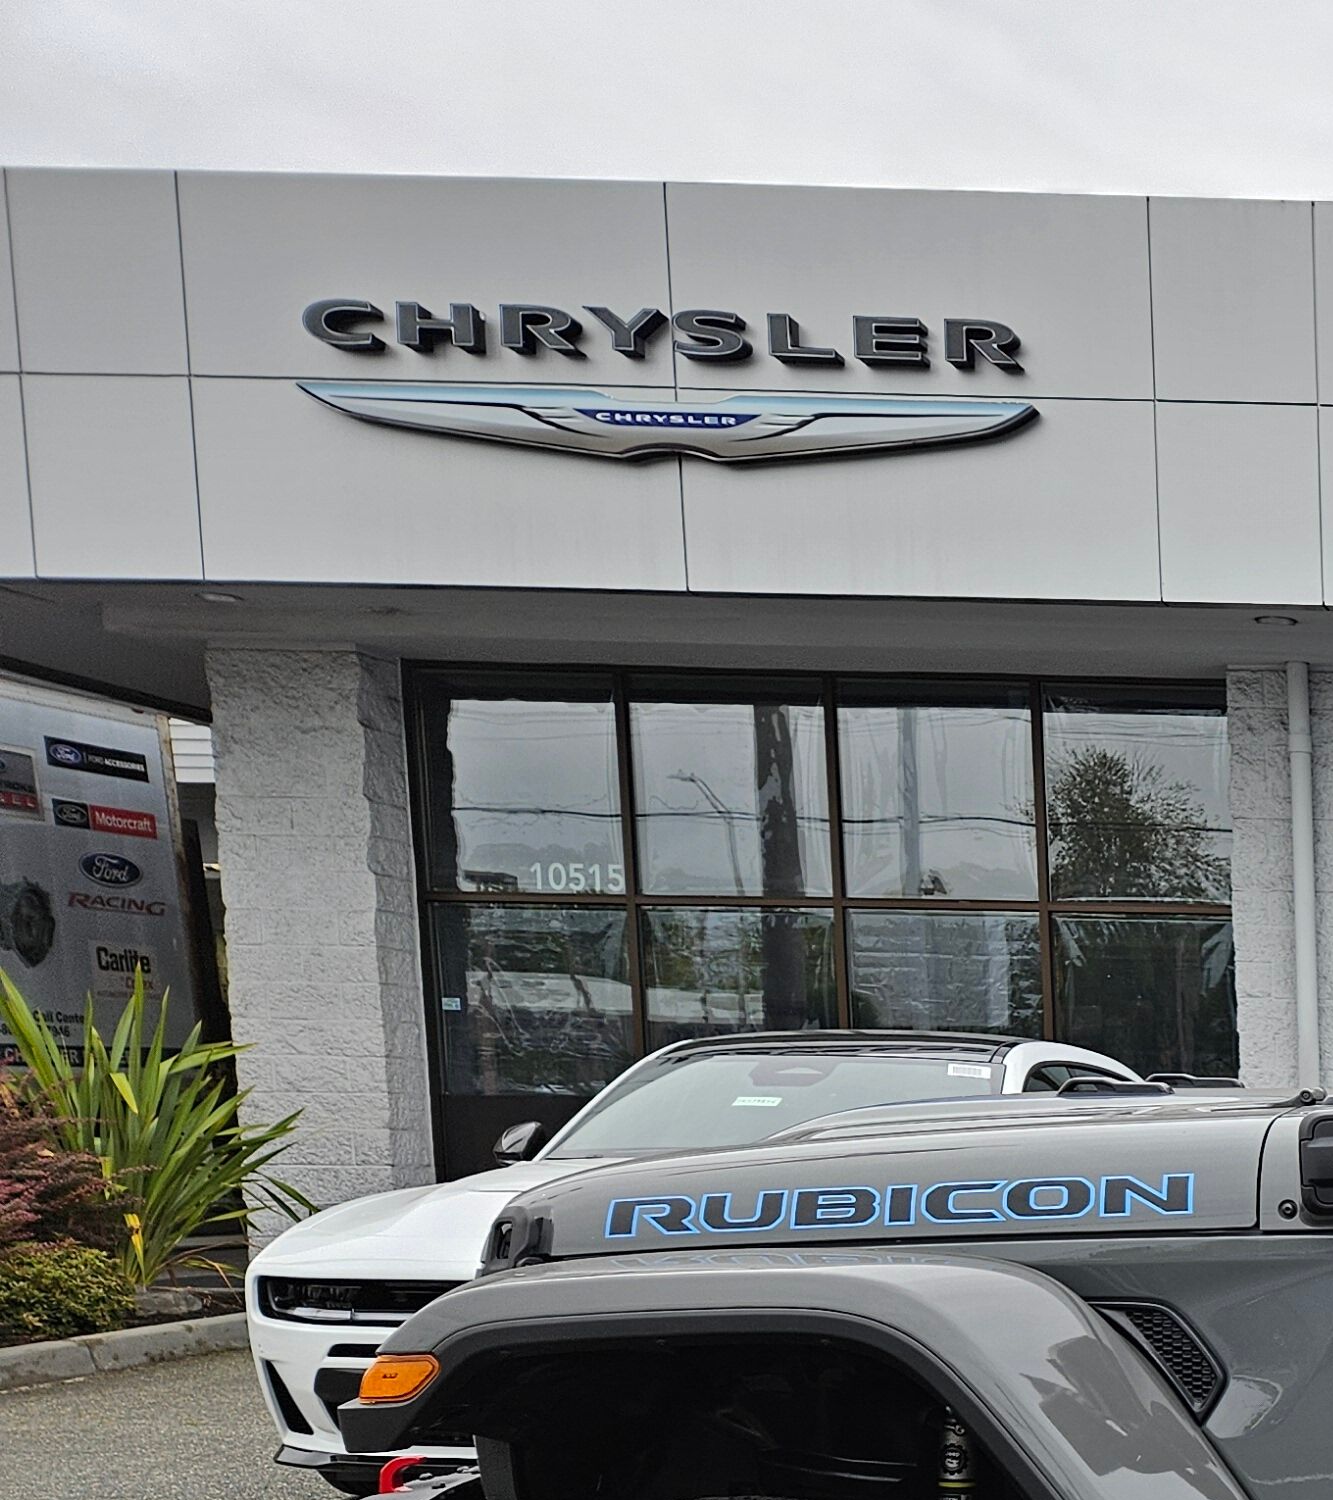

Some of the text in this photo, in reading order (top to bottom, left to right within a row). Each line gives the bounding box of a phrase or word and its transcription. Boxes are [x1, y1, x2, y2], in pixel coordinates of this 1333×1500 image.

[301, 298, 1026, 374] CHRYSLER
[595, 412, 736, 426] CHRYSLER
[95, 811, 153, 832] Motorcraft
[91, 855, 130, 882] Ford
[529, 861, 624, 892] 10515
[66, 891, 167, 917] RACING
[95, 946, 152, 974] Carlite
[604, 1172, 1194, 1238] RUBICON
